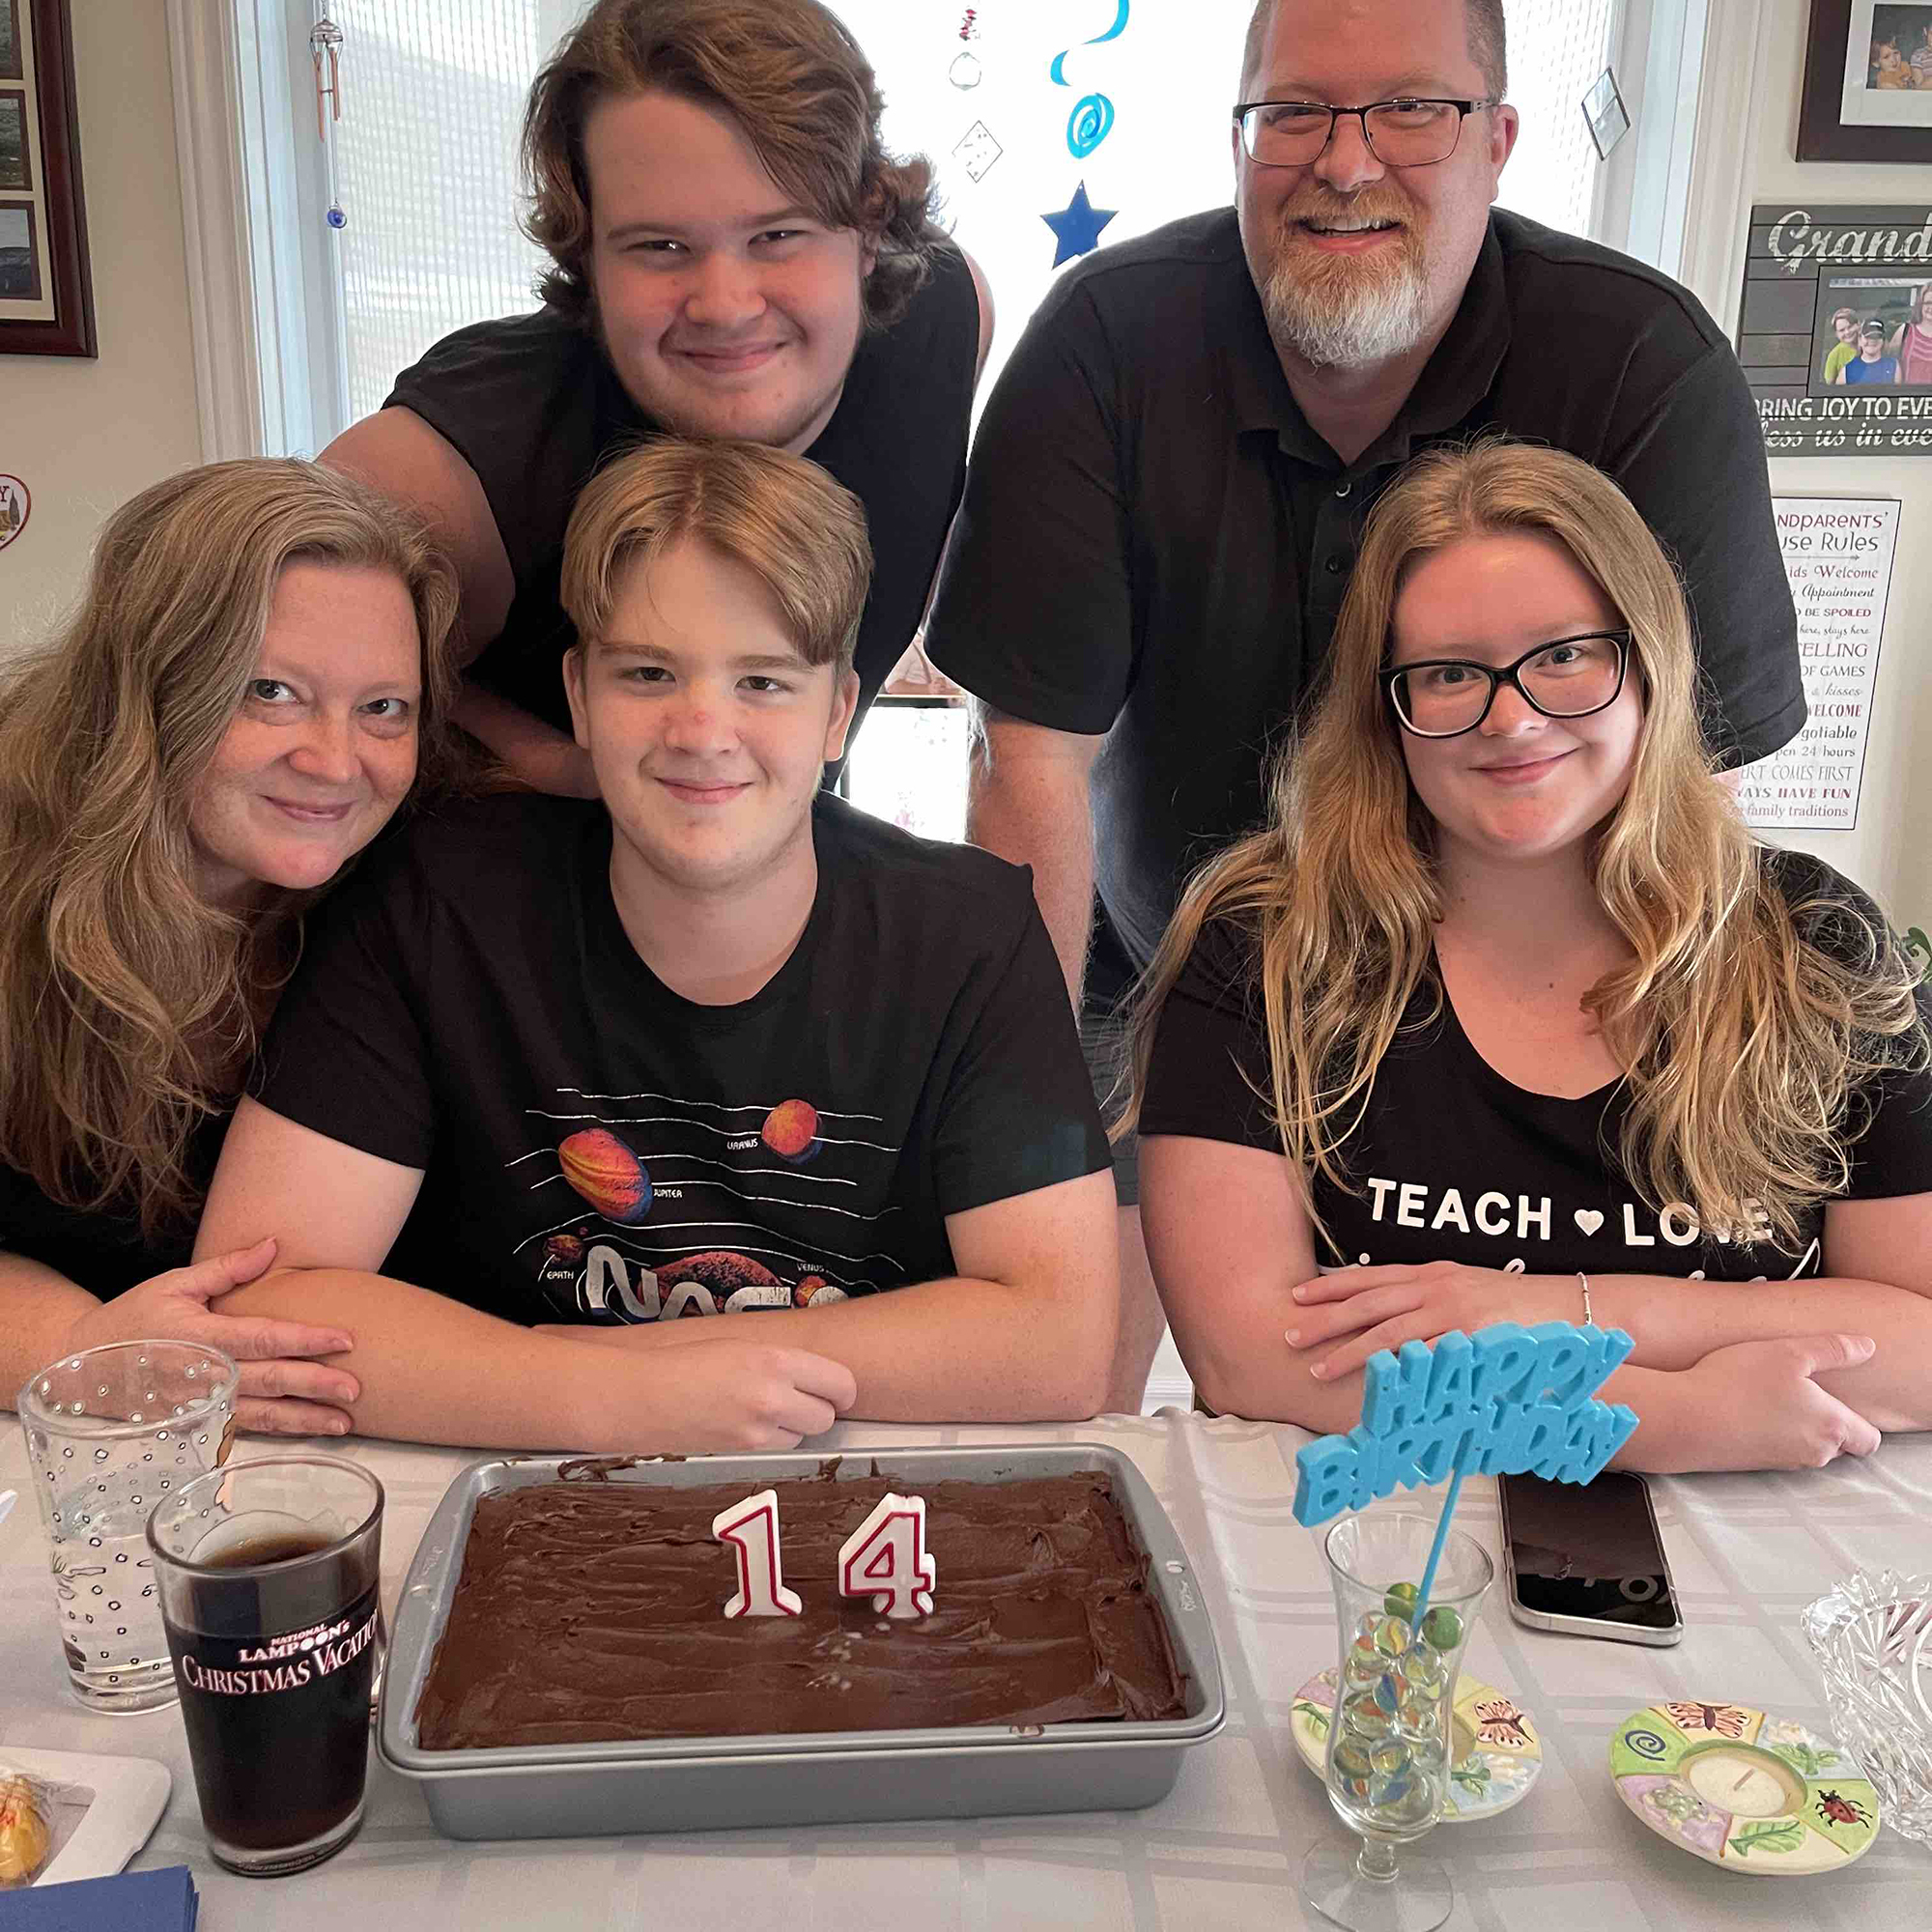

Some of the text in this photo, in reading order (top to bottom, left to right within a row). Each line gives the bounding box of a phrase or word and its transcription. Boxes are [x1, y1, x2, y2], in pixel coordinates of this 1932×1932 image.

[1817, 397, 1860, 421] JOY
[1862, 397, 1891, 420] TO
[1816, 429, 1845, 447] us
[1856, 422, 1884, 446] in
[1821, 531, 1879, 552] Rules
[1789, 564, 1879, 579] ids Welcome
[1802, 582, 1875, 601] Appointment
[1804, 608, 1820, 617] BE
[1824, 608, 1871, 617] SPOILED
[1851, 624, 1870, 635] here
[1799, 642, 1869, 658] ELLING
[1820, 666, 1865, 677] GAMES
[1825, 682, 1862, 696] kisses
[1797, 724, 1858, 742] gotiable
[1802, 745, 1817, 756] 24
[1823, 745, 1856, 757] hours
[1772, 764, 1814, 781] COMES
[1818, 765, 1855, 781] FIRST
[1778, 787, 1816, 798] HAVE
[1823, 787, 1852, 799] FUN
[1747, 803, 1786, 819] family
[1789, 804, 1849, 817] traditions
[726, 1138, 759, 1150] URANUS
[653, 1188, 683, 1198] JUPITER
[1367, 1178, 1774, 1246] TEACH LOE
[796, 1263, 825, 1272] VENUS
[1361, 1321, 1635, 1435] HAPPY
[1293, 1400, 1640, 1528] BIRTHDAY
[270, 1623, 328, 1646] NATIONAL
[182, 1654, 311, 1696] CHRISTMAS
